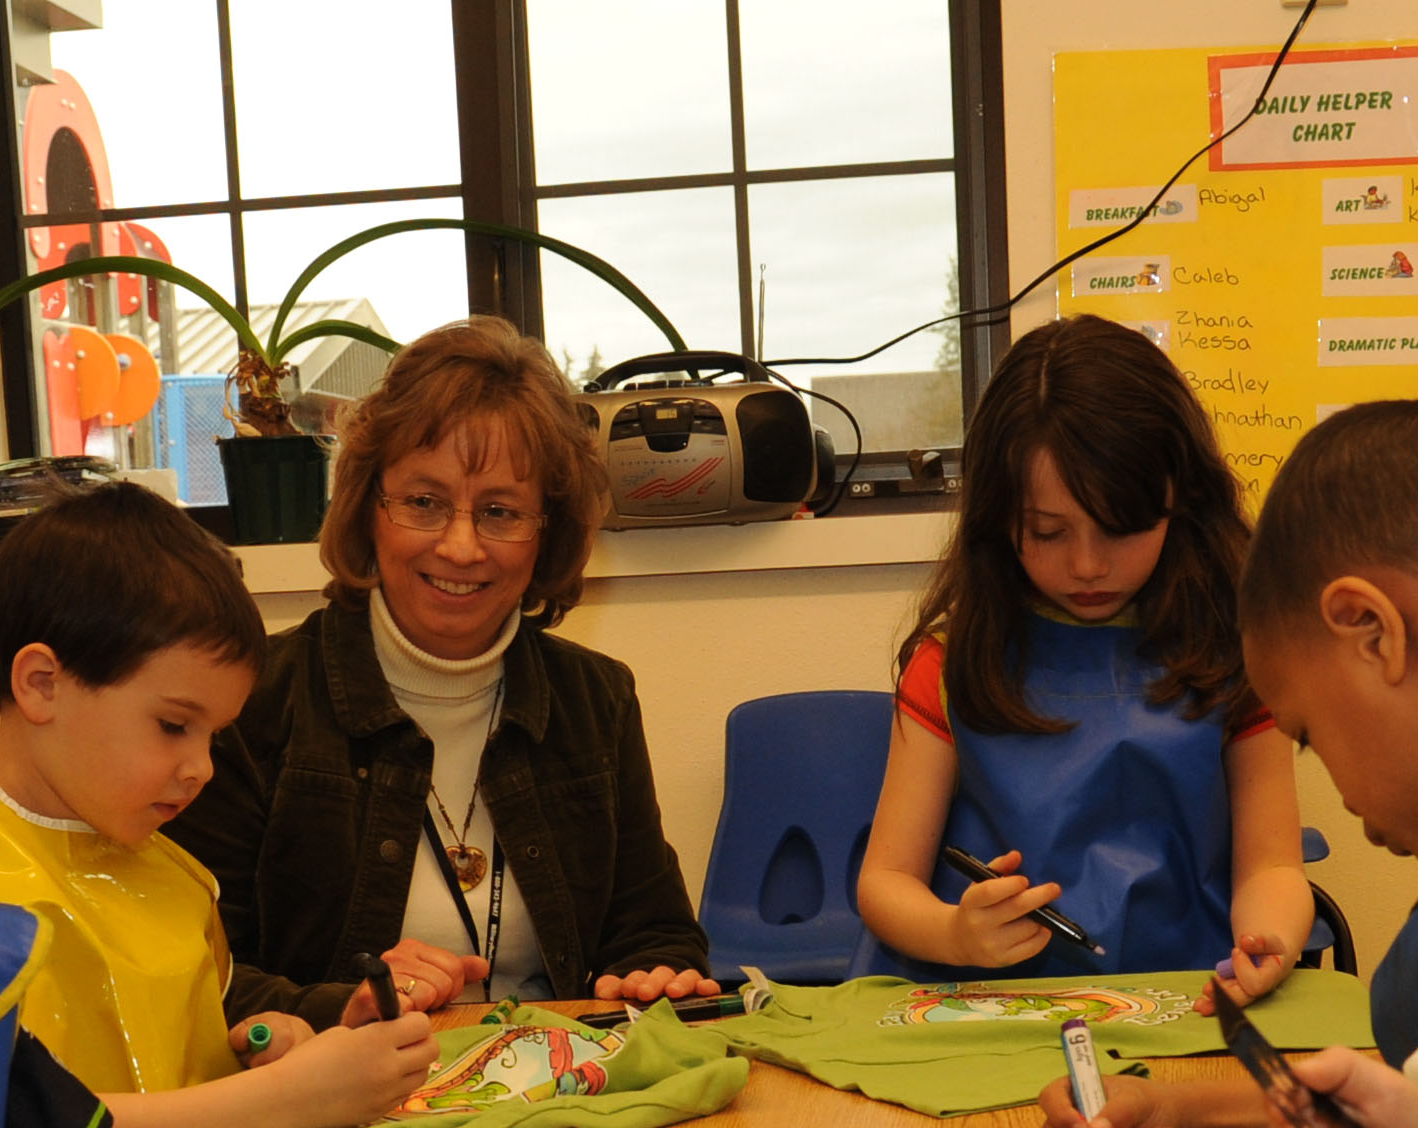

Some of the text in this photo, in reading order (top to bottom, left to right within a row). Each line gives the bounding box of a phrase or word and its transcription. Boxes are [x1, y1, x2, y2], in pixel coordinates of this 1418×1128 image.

[1255, 91, 1393, 116] DAILY HELPER
[1292, 122, 1356, 143] CHART
[1198, 188, 1266, 213] Abigal
[1335, 199, 1361, 213] ART
[1086, 204, 1160, 221] BREAKFAT
[1173, 266, 1240, 287] Caleb
[1329, 267, 1384, 280] SCIENCE
[1089, 275, 1136, 290] CHAIRS
[1328, 338, 1397, 353] DRAMATIC
